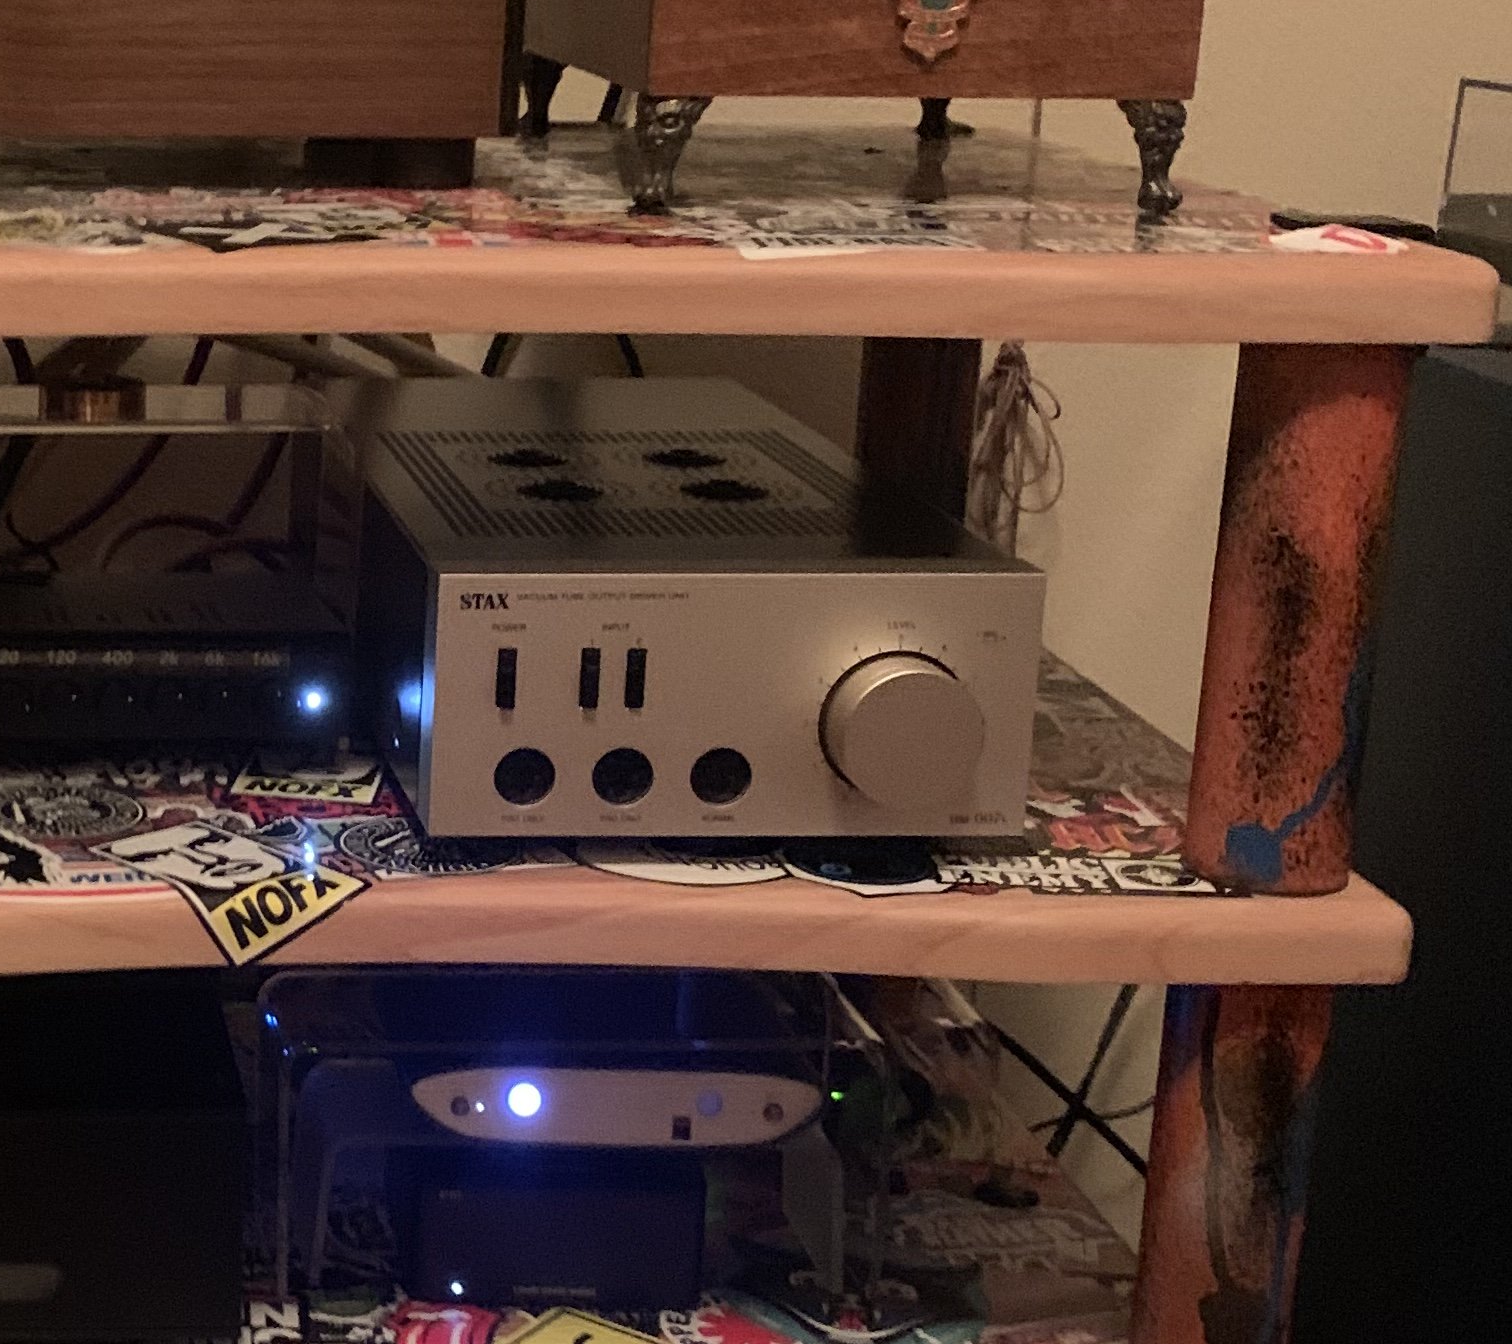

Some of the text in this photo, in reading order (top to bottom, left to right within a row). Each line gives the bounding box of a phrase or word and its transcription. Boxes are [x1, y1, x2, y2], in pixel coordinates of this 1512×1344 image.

[459, 592, 510, 611] STAX
[46, 649, 77, 666] 120
[101, 649, 134, 666] 400
[244, 774, 364, 800] NOFX
[223, 868, 342, 952] NOFX
